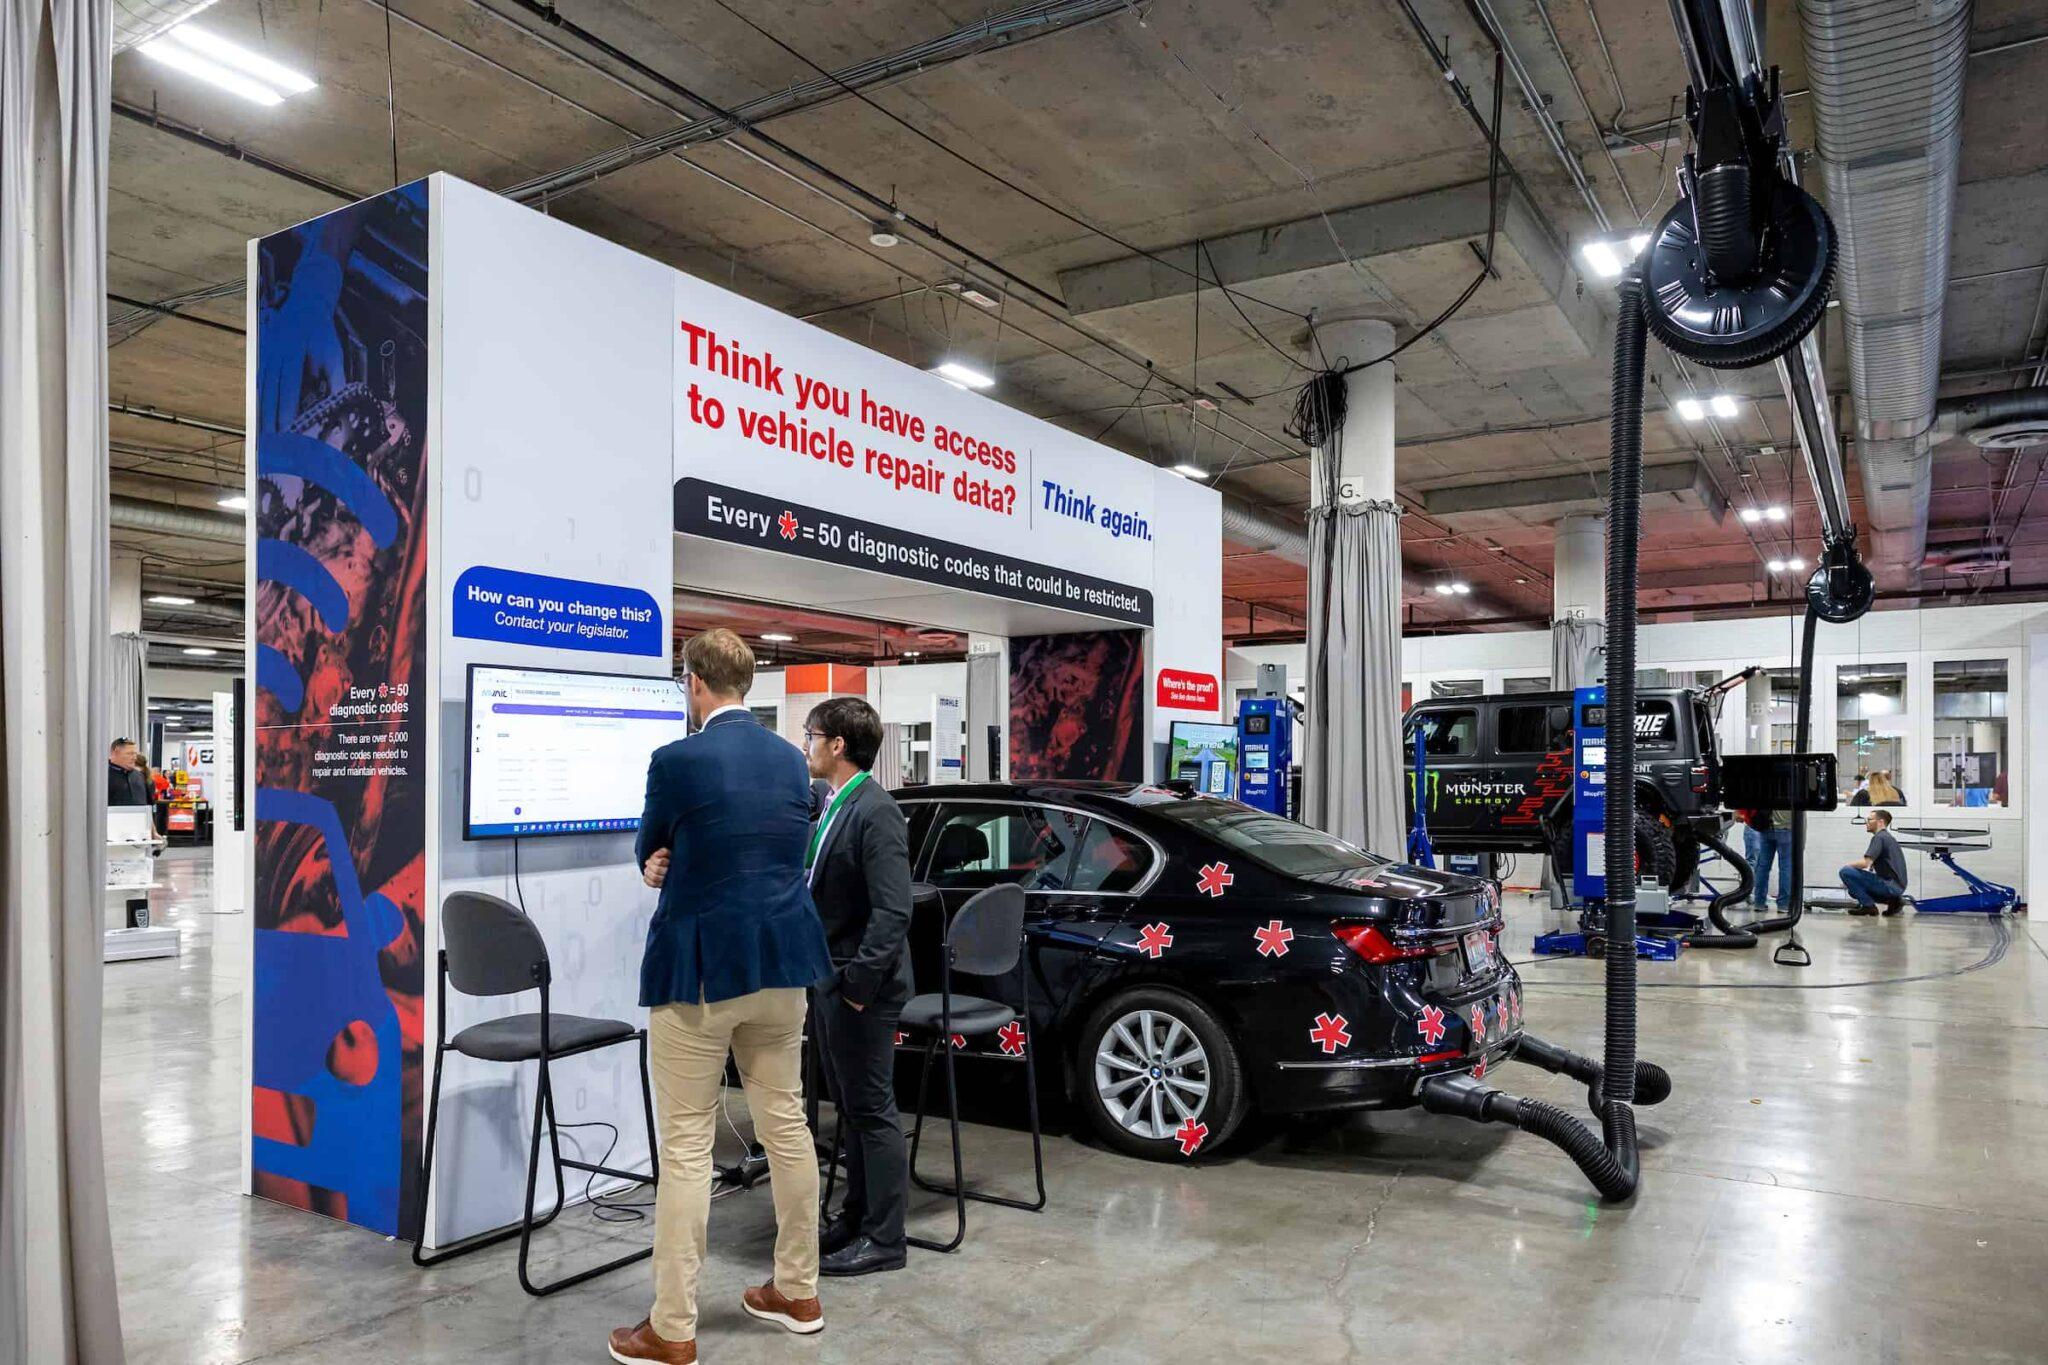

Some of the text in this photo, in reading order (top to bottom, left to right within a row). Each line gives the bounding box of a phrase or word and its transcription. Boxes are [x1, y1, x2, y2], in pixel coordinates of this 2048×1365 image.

[681, 320, 1016, 474] Think you have access
[687, 383, 1016, 515] to vehicle repair data?
[1042, 480, 1152, 541] Think again.
[707, 495, 771, 537] Every
[847, 530, 940, 570] diagnostic
[944, 556, 990, 581] codes
[994, 564, 1023, 588] that
[1026, 575, 1062, 596] could
[1065, 579, 1081, 600] be
[1083, 588, 1141, 613] restricted.
[467, 584, 652, 623] How can you change this?
[494, 611, 630, 640] Contact your legislator.
[350, 686, 376, 701] Every
[1186, 680, 1197, 692] the
[329, 700, 409, 719] diagnostic codes
[338, 731, 408, 745] There are over 5,000
[314, 748, 408, 763] diagnostic codes needed to
[312, 765, 408, 778] repair and maintain vehicles.
[1445, 781, 1527, 797] MONSTER
